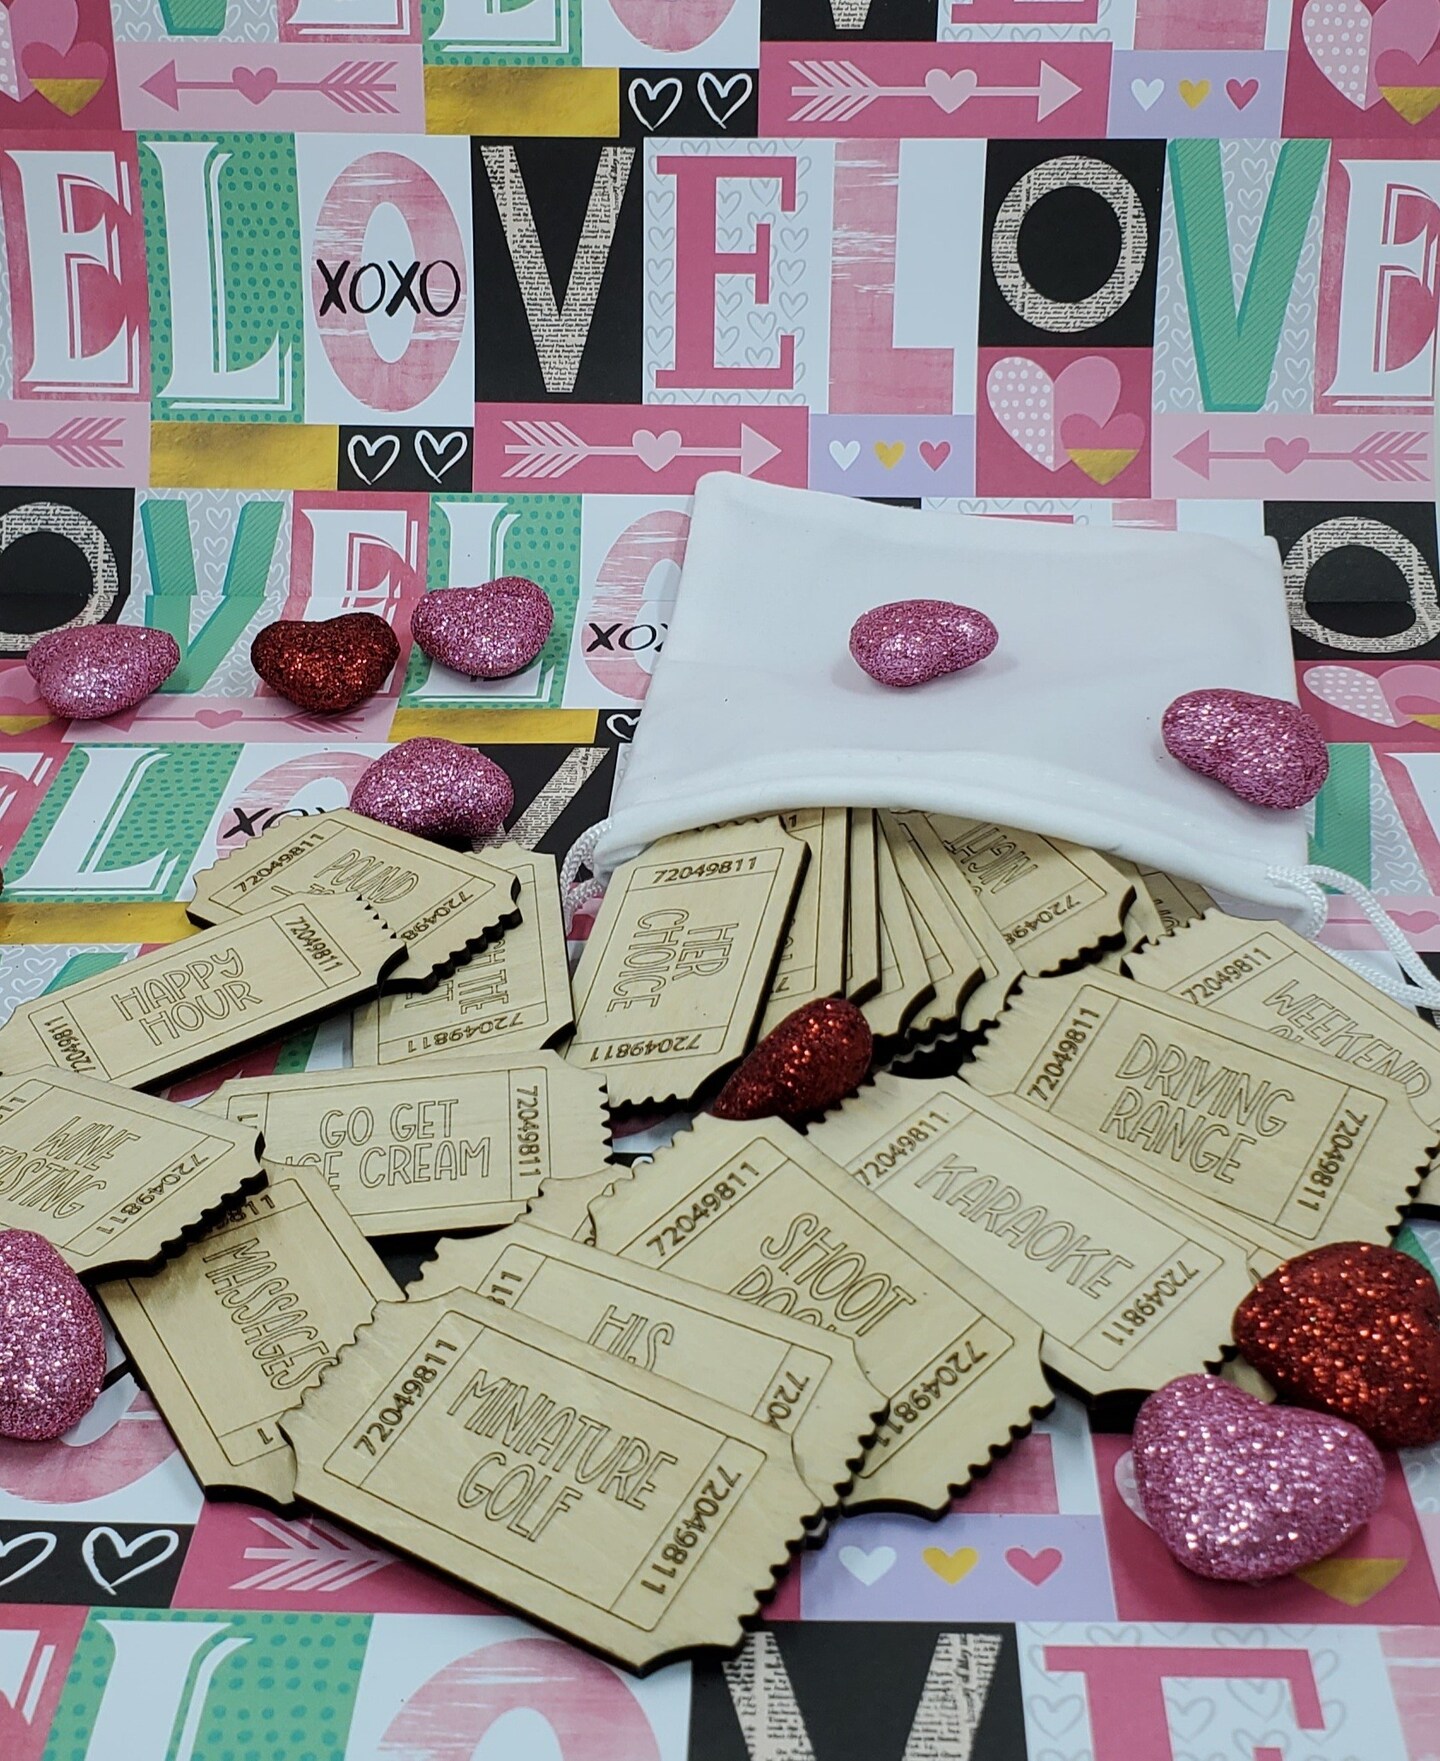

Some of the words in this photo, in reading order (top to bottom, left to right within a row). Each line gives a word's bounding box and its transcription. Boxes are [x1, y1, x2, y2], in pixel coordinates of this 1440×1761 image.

[316, 259, 462, 317] XOXO
[233, 832, 325, 893] 72049811
[652, 856, 758, 885] 72049811
[110, 947, 245, 1022] HAPPY
[284, 916, 344, 973] 72049811
[607, 908, 690, 1013] CHOICE
[672, 922, 739, 982] HER
[1181, 947, 1273, 1005] 72049811
[139, 980, 264, 1047] HOUR
[408, 1012, 524, 1053] 72049811
[458, 968, 509, 1015] THE
[589, 1033, 703, 1063] 72049811
[1026, 1007, 1100, 1102] 72049811
[1115, 1033, 1295, 1138] DRIVING
[33, 1116, 142, 1171] WINE
[319, 1107, 374, 1149] GO
[390, 1098, 460, 1141] GET
[358, 1136, 492, 1188] CREAM
[515, 1085, 542, 1178] 72049811
[853, 1110, 950, 1187] 72049811
[1099, 1086, 1257, 1185] RANGE
[1297, 1109, 1369, 1212] 72049811
[95, 1153, 211, 1235] 72049811
[645, 1161, 761, 1258] 72049811
[913, 1153, 1136, 1300] KARAOKE
[202, 1237, 340, 1390] MASSAGES
[759, 1212, 917, 1338] SHOOT
[1101, 1259, 1201, 1347] 72049811
[352, 1338, 460, 1458] 72049811
[446, 1367, 679, 1511] MINIATURE
[456, 1451, 583, 1544] GOLF
[640, 1464, 743, 1597] 72049811
